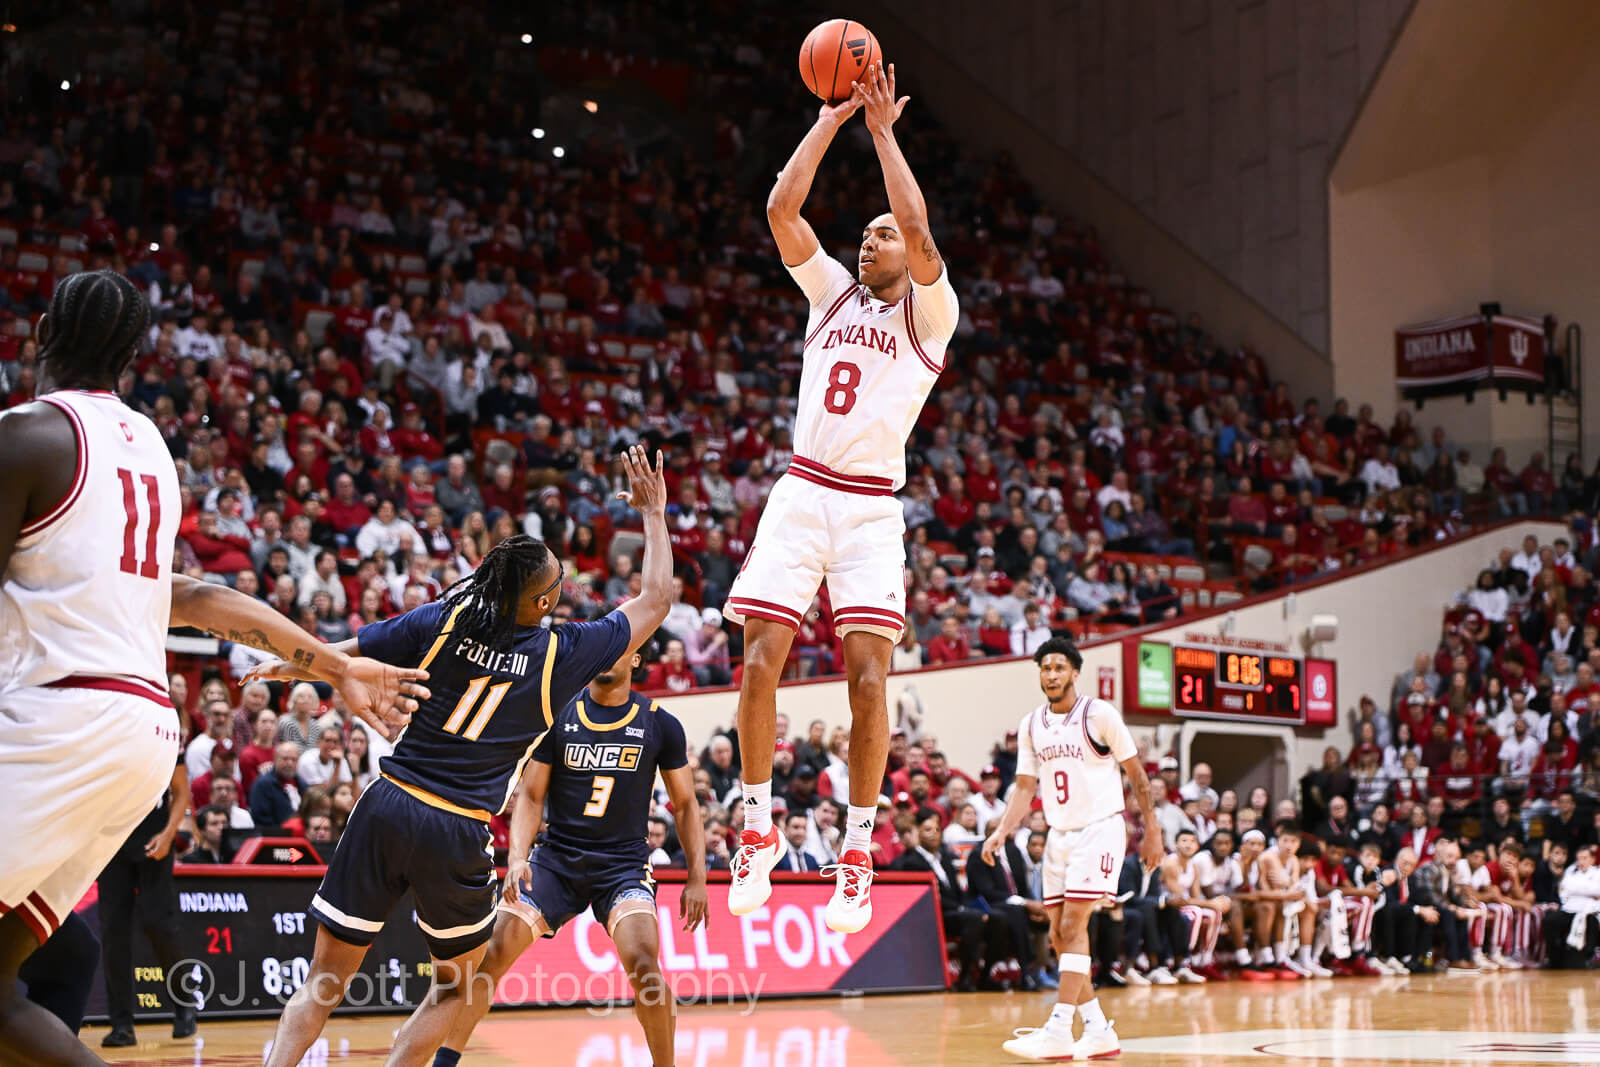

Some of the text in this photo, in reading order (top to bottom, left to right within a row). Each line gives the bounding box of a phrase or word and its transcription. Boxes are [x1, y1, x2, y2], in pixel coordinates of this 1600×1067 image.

[822, 325, 897, 360] INIANA
[1403, 329, 1475, 361] INDIANA
[824, 361, 862, 416] 8
[117, 467, 161, 580] 11
[1181, 674, 1203, 704] 21
[442, 675, 513, 742] 11
[565, 744, 643, 771] UNCG
[1036, 744, 1084, 766] NDIANA
[583, 776, 615, 818] 3
[1054, 771, 1069, 804] 9
[179, 892, 248, 912] INDIANA
[272, 912, 306, 934] 1ST
[574, 904, 852, 973] CLL FOR
[206, 926, 232, 954] 21
[134, 964, 203, 983] FOUL 4
[262, 956, 314, 996] 8:0
[136, 993, 161, 1008] TOL
